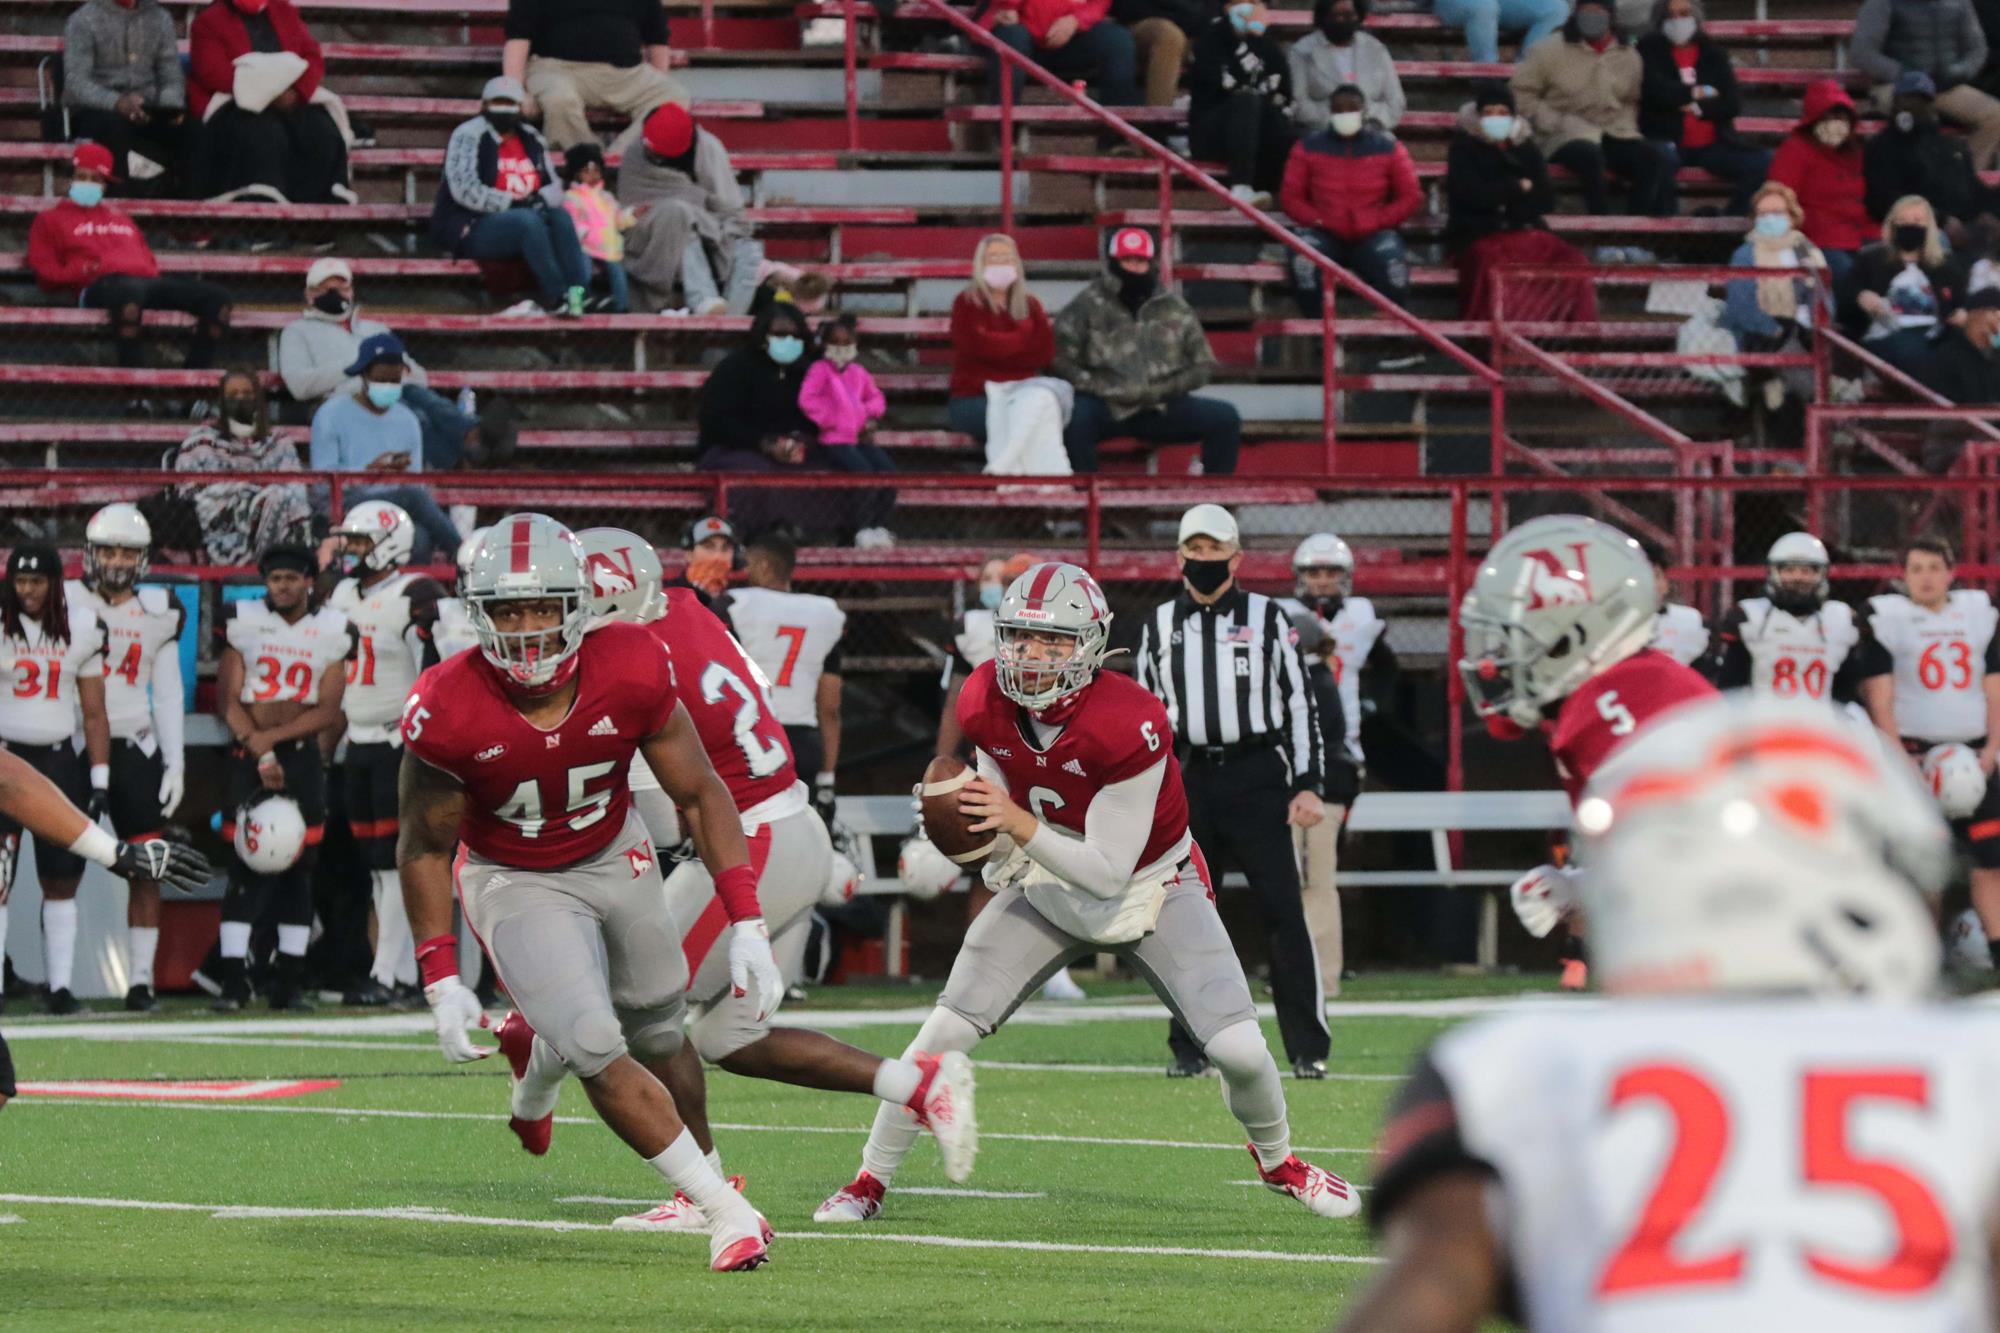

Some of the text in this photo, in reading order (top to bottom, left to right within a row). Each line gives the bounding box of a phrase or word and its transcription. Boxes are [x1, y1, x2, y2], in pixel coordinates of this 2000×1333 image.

[1018, 610, 1048, 619] Riddell
[775, 625, 807, 687] 7
[1171, 630, 1183, 644] S
[13, 658, 62, 700] 31
[254, 655, 312, 702] 39
[1235, 656, 1249, 676] R
[1771, 655, 1828, 700] 80
[1918, 641, 1972, 689] 63
[700, 630, 789, 779] 2
[1596, 690, 1636, 736] 5
[478, 745, 504, 761] SAC
[545, 733, 560, 749] N
[1140, 720, 1160, 752] 6
[1036, 755, 1047, 767] N
[494, 760, 617, 838] 45
[1594, 1060, 1957, 1297] 25
